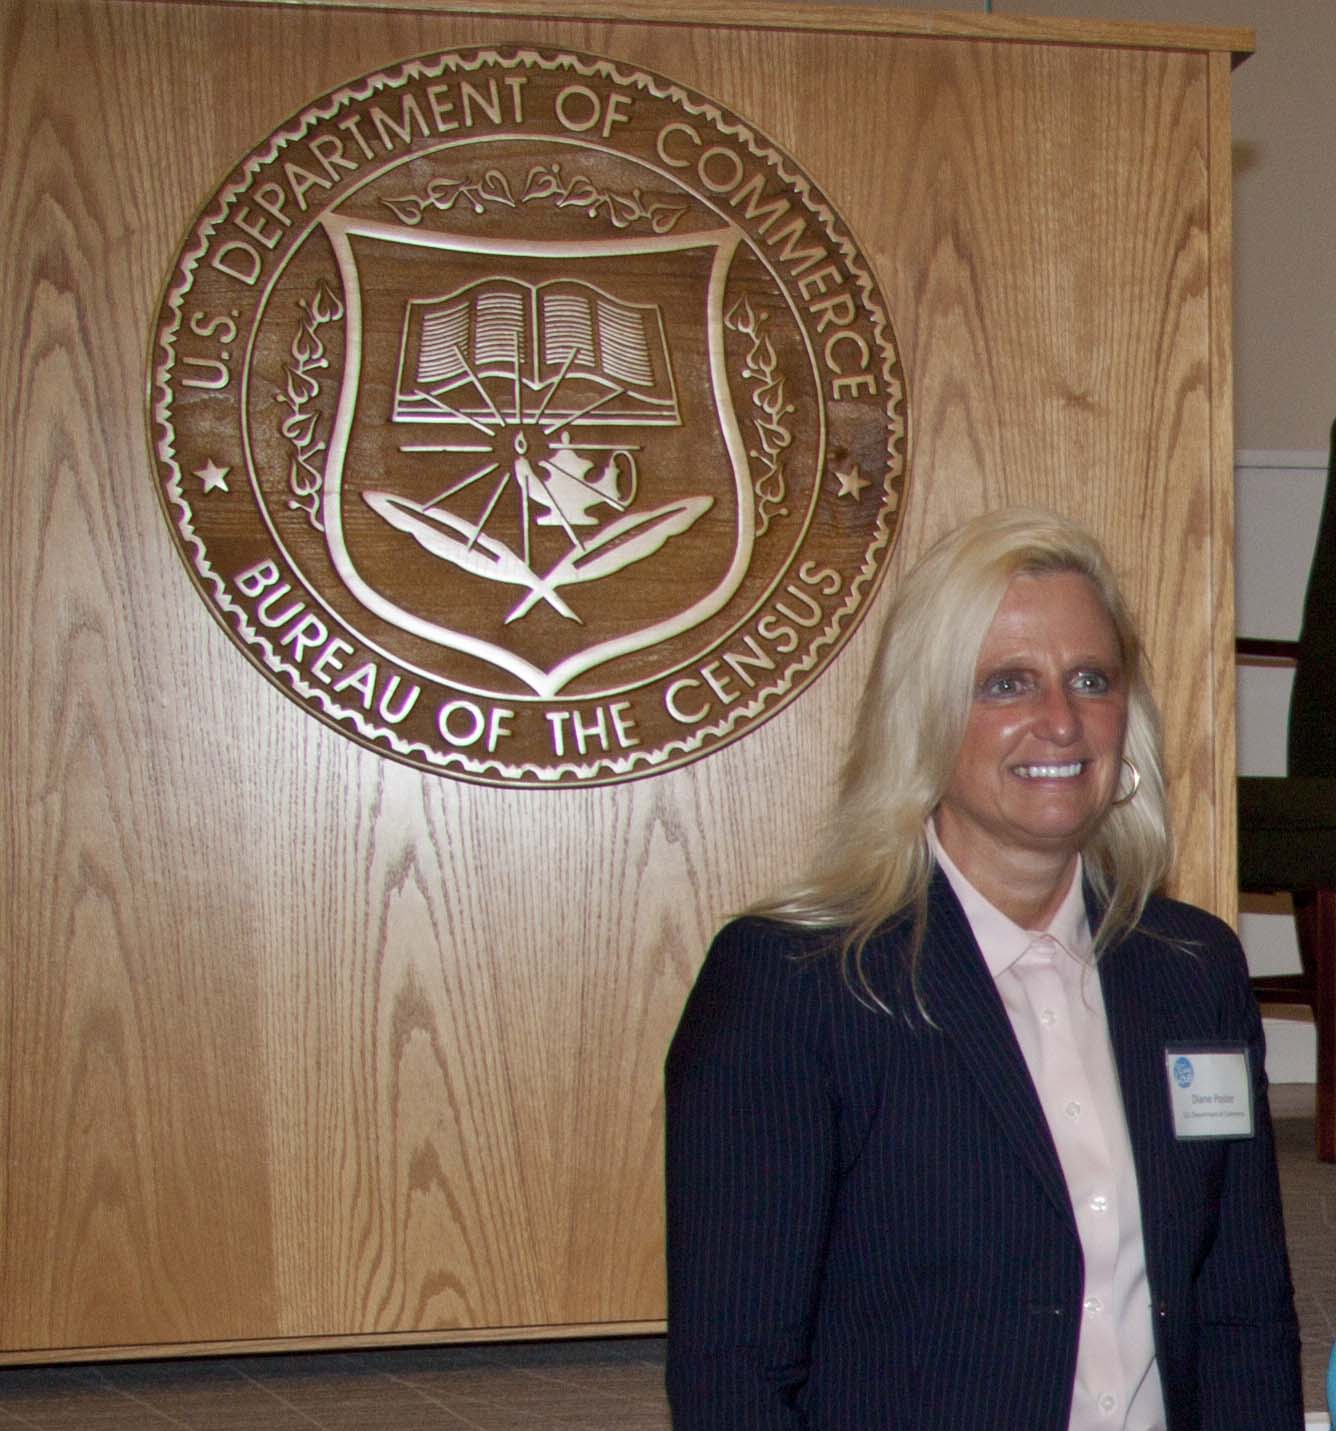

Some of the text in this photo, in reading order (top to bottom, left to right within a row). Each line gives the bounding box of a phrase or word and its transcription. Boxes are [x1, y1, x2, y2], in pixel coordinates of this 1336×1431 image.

[182, 77, 878, 400] U.S. DEPARTMENT OF COMMERCE
[234, 558, 842, 757] BUREAU OF THE CENSUS
